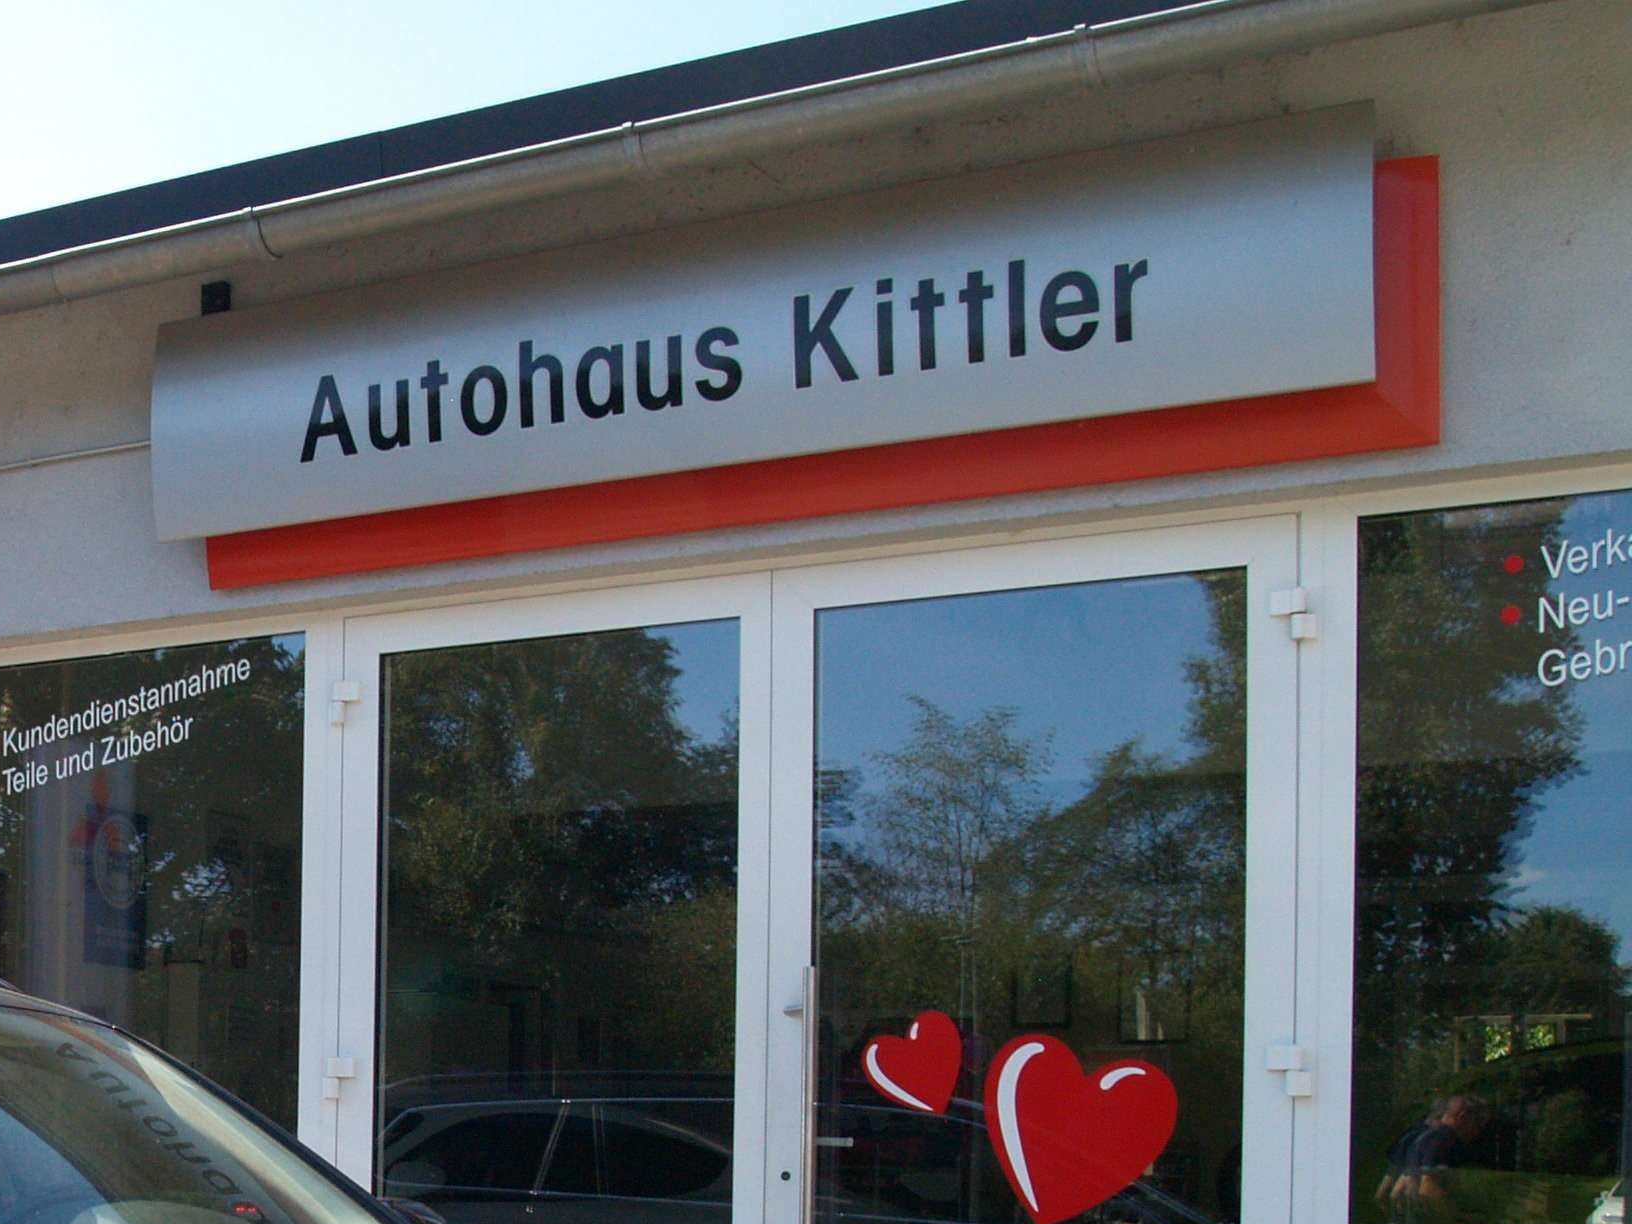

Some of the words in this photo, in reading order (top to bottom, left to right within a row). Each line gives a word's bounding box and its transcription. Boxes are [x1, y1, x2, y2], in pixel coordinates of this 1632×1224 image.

[299, 321, 743, 464] Autohaus
[792, 258, 1149, 390] Kittler
[1537, 590, 1629, 634] Neu-
[1, 656, 251, 758] Kundendienstannahme
[2, 760, 49, 797] Teile
[55, 742, 95, 781] und
[102, 716, 194, 768] Zubehör
